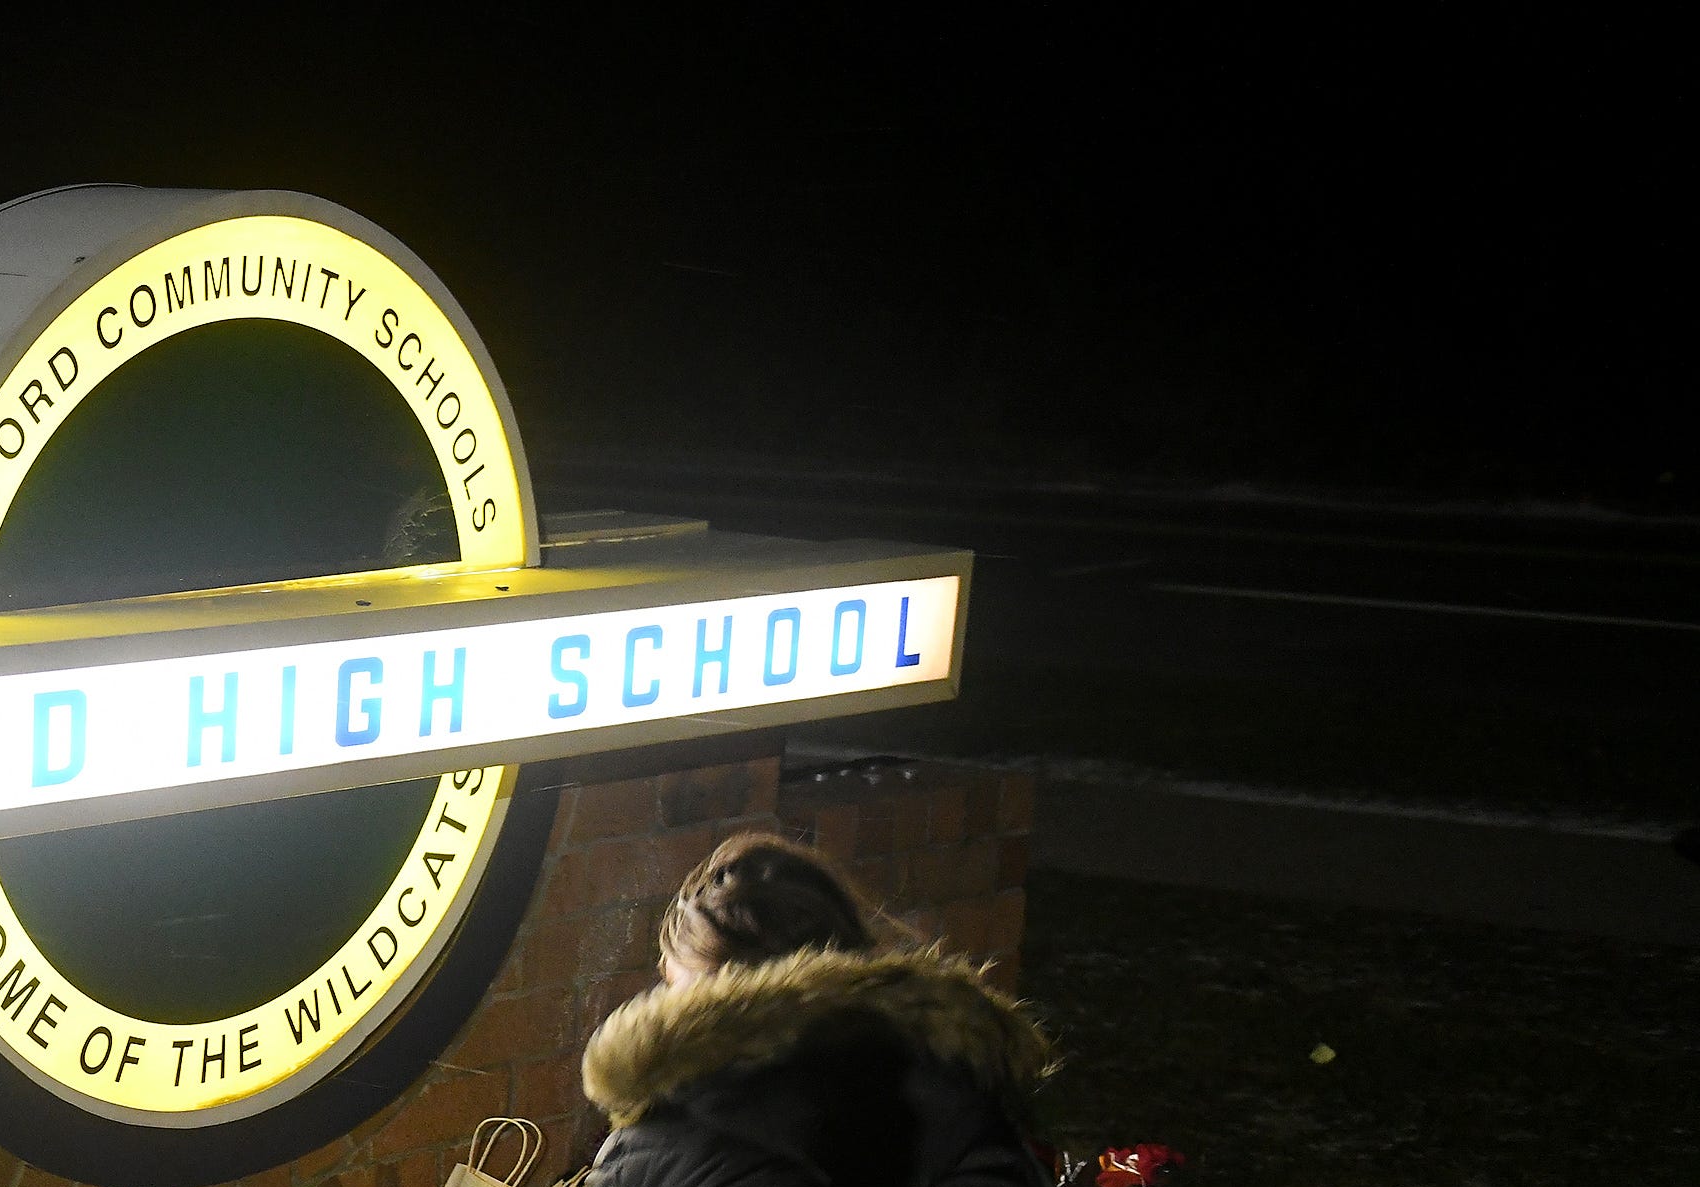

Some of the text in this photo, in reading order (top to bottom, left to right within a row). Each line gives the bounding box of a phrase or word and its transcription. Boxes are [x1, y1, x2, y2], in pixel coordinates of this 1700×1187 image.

[95, 255, 367, 350] COMMUNITY
[374, 307, 497, 533] SCHOOLS
[186, 646, 467, 768] HIGH
[547, 596, 921, 720] SCHOOL
[79, 1025, 147, 1084] OF
[172, 1024, 263, 1088] THE
[284, 768, 485, 1047] WILDCATS
